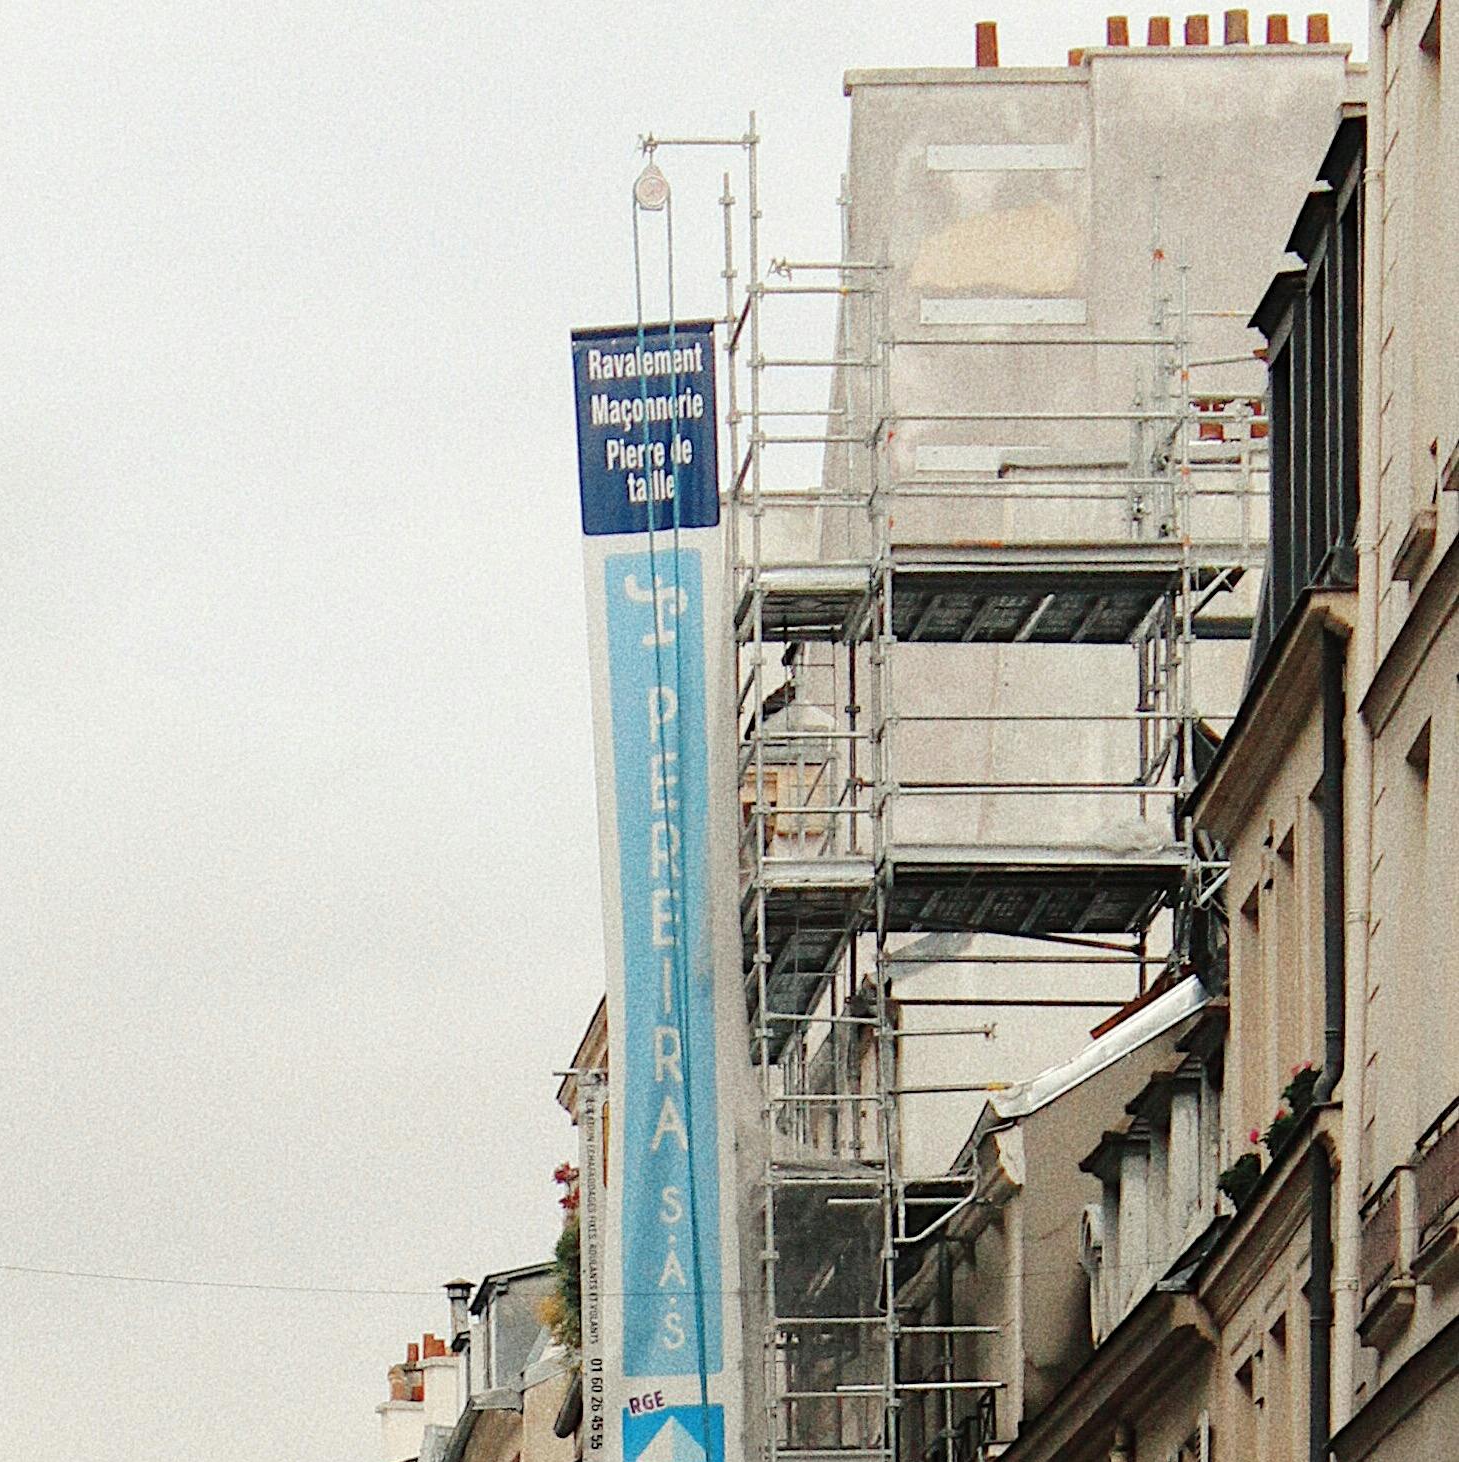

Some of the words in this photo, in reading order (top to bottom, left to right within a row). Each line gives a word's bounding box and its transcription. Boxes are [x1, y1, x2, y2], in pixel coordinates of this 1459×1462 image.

[587, 342, 703, 381] Ravalement
[605, 437, 665, 471] Pierre
[626, 469, 676, 504] talle
[646, 684, 689, 1153] PEREIRA
[590, 1358, 603, 1372] 01
[590, 1378, 603, 1393] 60
[628, 1390, 665, 1414] RGE
[590, 1415, 603, 1431] 45
[590, 1434, 603, 1450] 55
